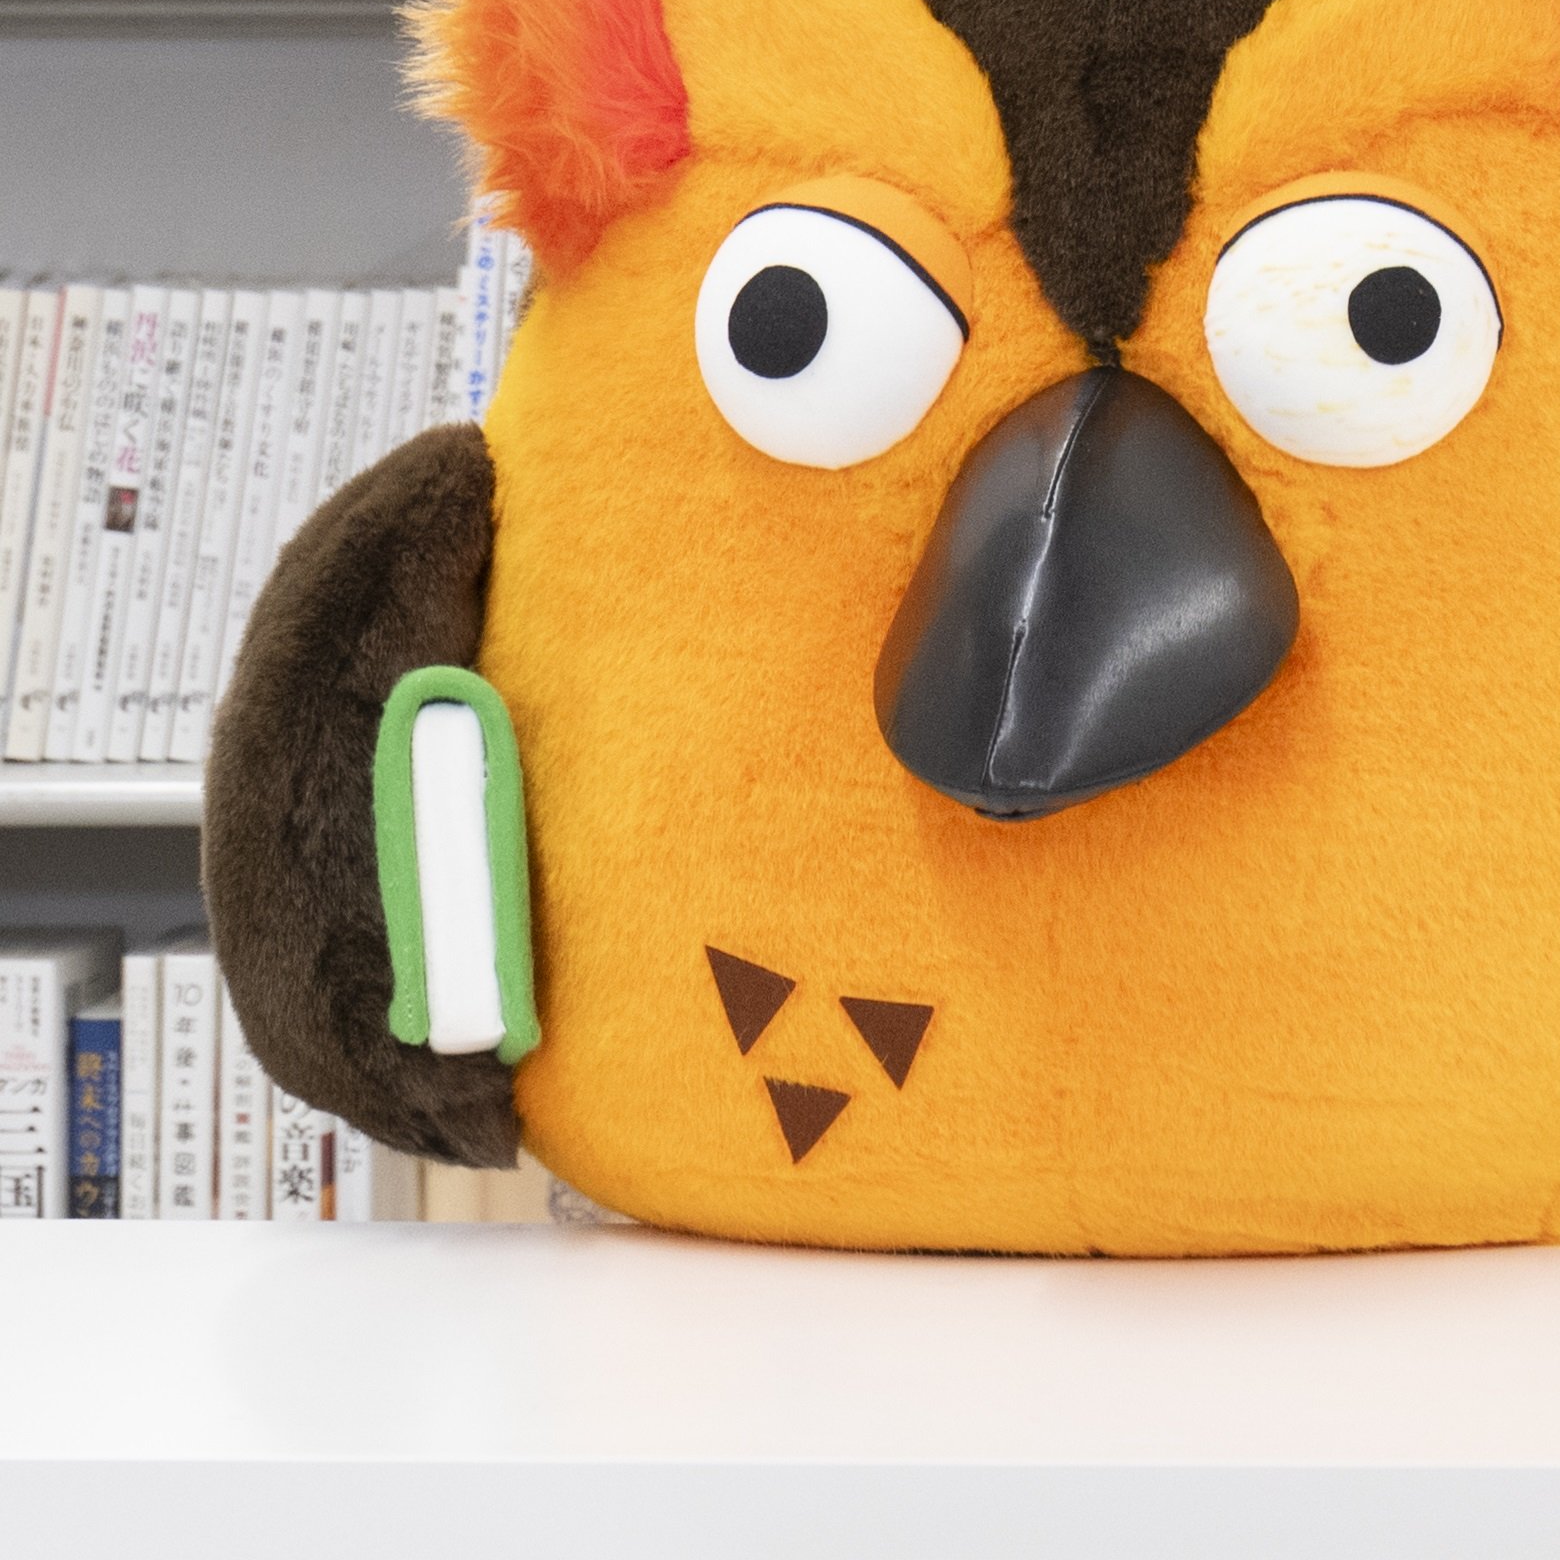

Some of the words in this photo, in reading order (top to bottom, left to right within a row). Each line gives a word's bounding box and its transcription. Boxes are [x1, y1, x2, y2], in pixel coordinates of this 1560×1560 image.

[115, 312, 158, 474] 丹沢に咲く花
